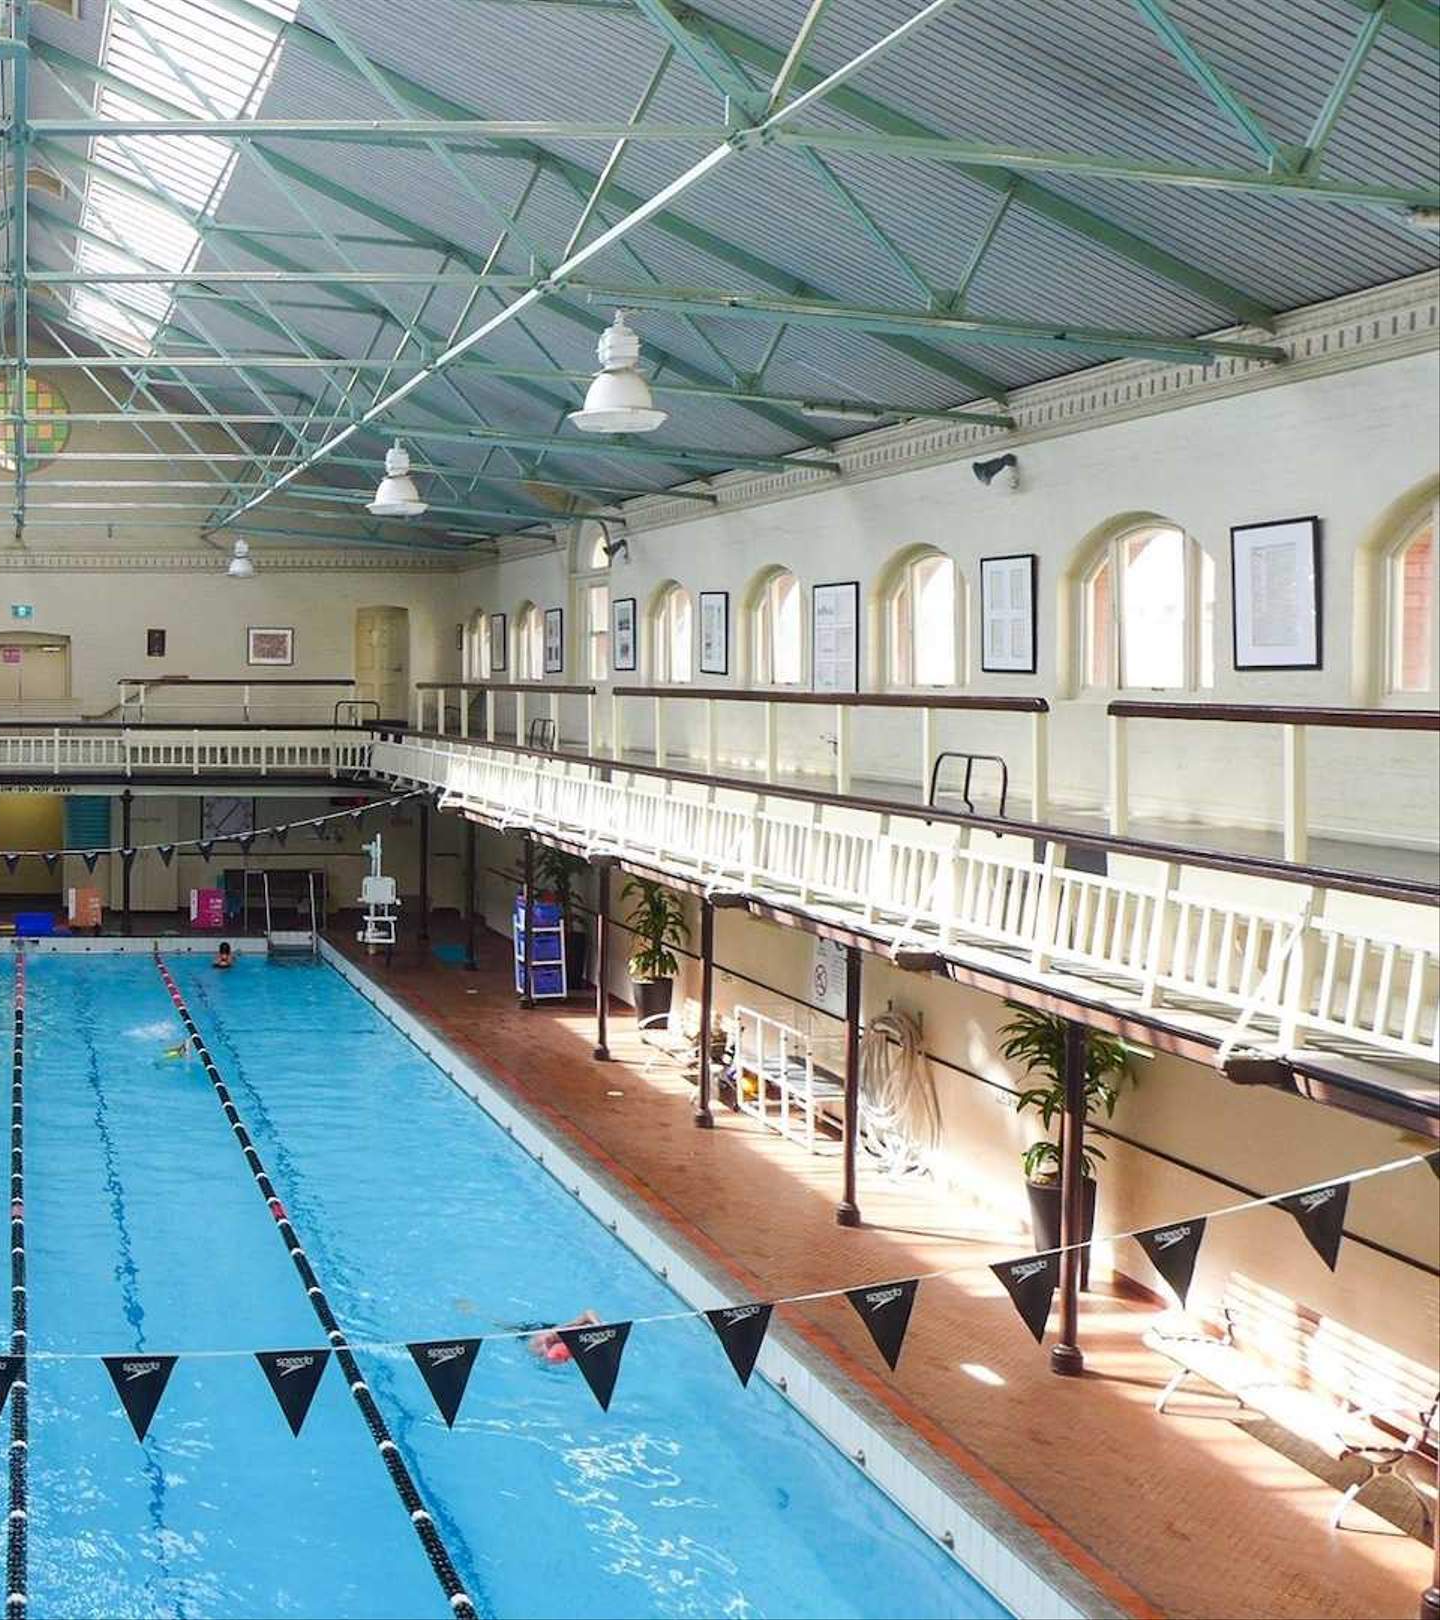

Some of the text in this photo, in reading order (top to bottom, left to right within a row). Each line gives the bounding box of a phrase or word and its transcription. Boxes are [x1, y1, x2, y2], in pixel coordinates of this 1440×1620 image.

[1300, 1188, 1337, 1205] speedo
[1154, 1226, 1191, 1242] speedo
[1011, 1260, 1047, 1276] speedo
[865, 1288, 902, 1302] speedo
[579, 1330, 617, 1343] speedo
[427, 1345, 465, 1358] speedo
[122, 1361, 160, 1372] speedo
[276, 1356, 314, 1368] speedo
